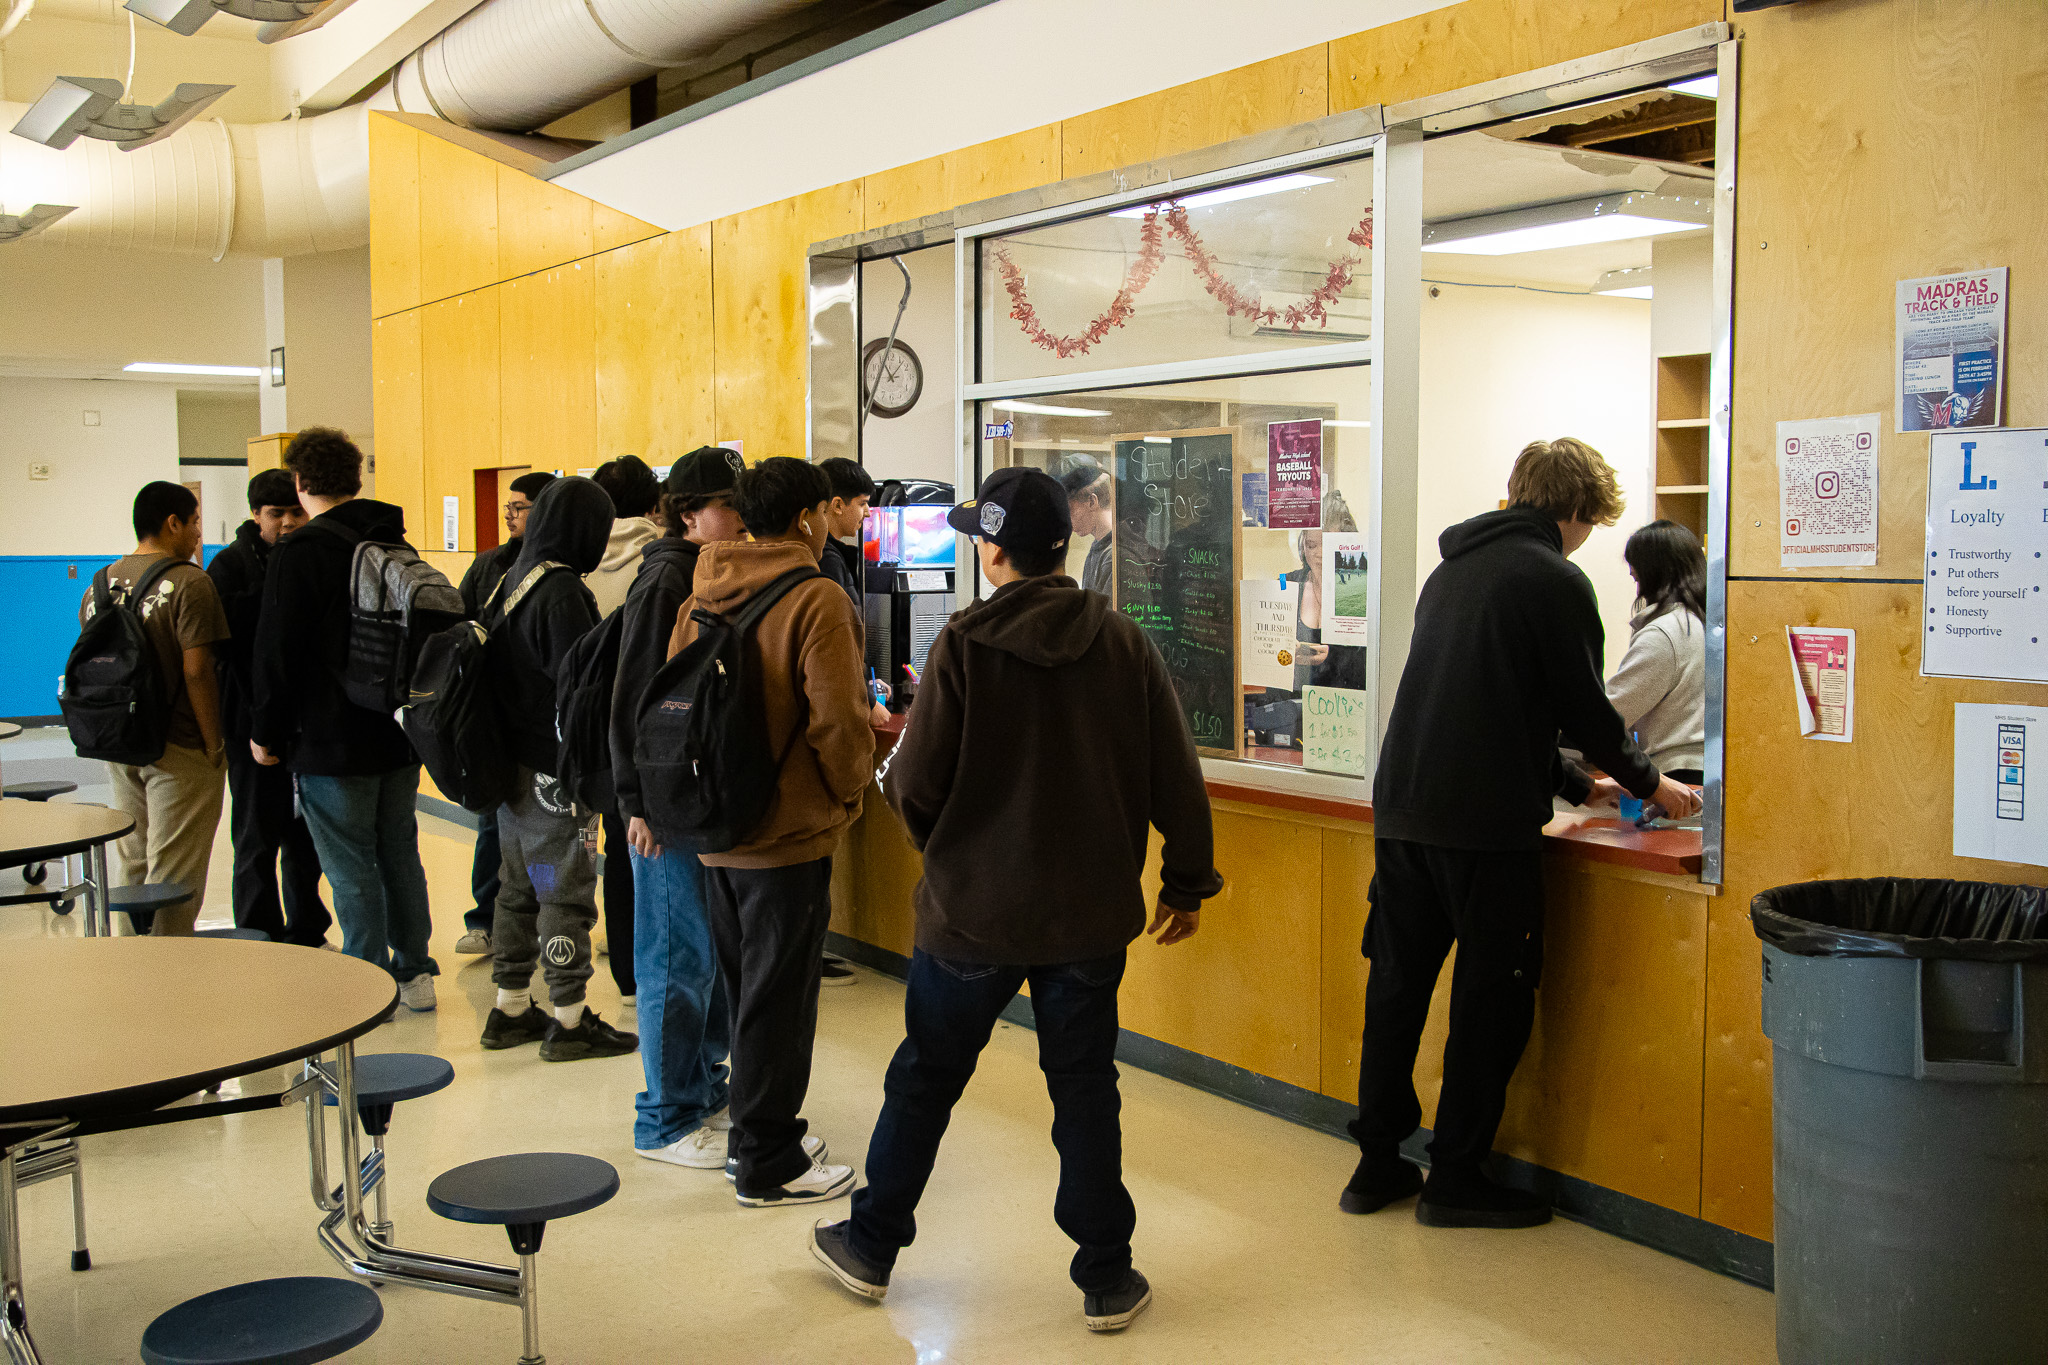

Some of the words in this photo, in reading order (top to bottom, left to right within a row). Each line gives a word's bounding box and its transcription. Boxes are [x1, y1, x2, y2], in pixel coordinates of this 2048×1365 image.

[1917, 278, 1989, 301] MADRAS
[1904, 298, 1948, 314] TRACK
[1952, 297, 1961, 308] &
[1965, 292, 1999, 307] FIELD
[1931, 402, 1953, 426] M
[1130, 444, 1231, 484] Student
[1276, 461, 1313, 472] BASEBALL
[1959, 442, 1998, 491] L.
[1276, 471, 1311, 482] TRYOUTS
[1143, 483, 1211, 520] Store
[1950, 508, 2005, 527] Loyalty
[1189, 547, 1219, 566] SNACKS
[1948, 548, 2012, 562] Trustworthy
[1947, 567, 1965, 579] Put
[1967, 568, 1999, 579] others
[1947, 586, 1979, 598] before
[1982, 587, 2028, 601] yourself
[1272, 612, 1285, 622] AND
[1946, 605, 1989, 619] Honesty
[1945, 624, 2003, 638] Supportive
[1193, 711, 1222, 738] $1.50
[2002, 735, 2022, 746] VISA
